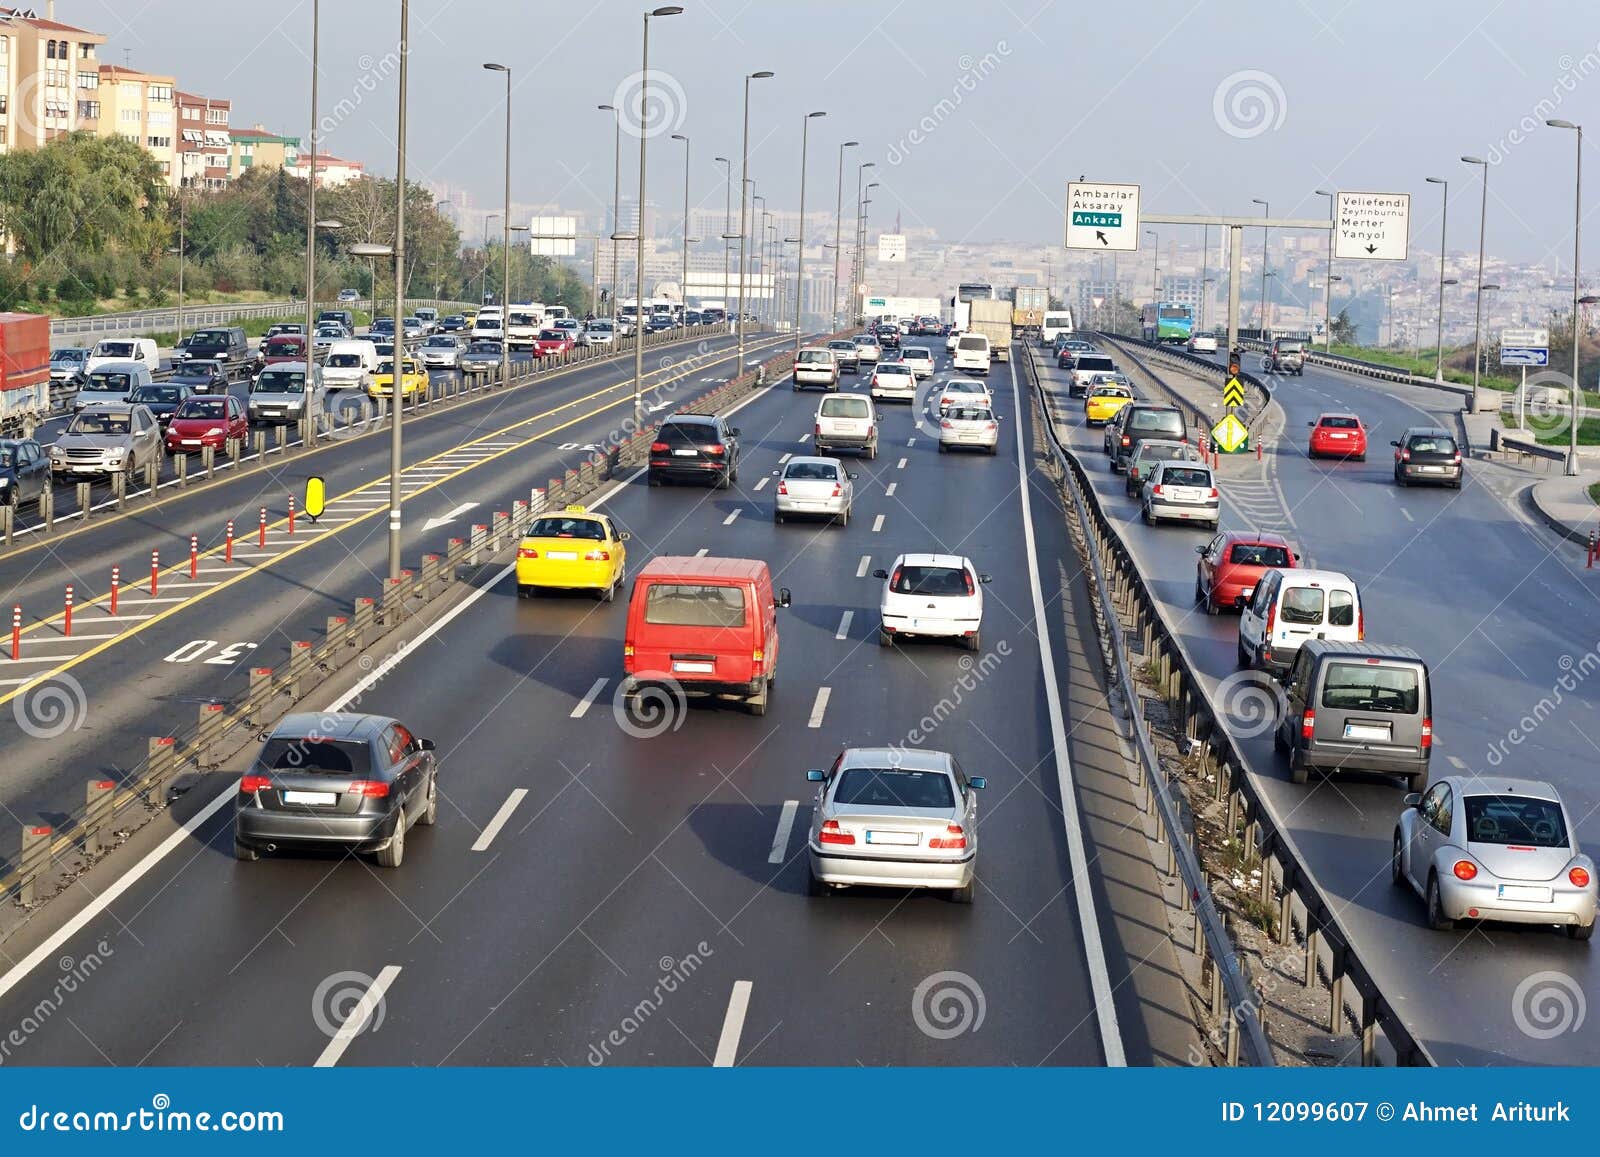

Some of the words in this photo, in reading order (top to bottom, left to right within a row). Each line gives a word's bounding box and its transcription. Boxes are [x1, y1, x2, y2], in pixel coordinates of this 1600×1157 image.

[1073, 189, 1134, 199] Ambarlar
[1073, 201, 1123, 212] Aksaray
[1343, 197, 1405, 207] Veliefendi
[1342, 207, 1404, 217] Zeytinburnu
[1075, 214, 1120, 225] Ankara
[1341, 218, 1385, 228] Merter
[1342, 230, 1385, 241] Yanyol
